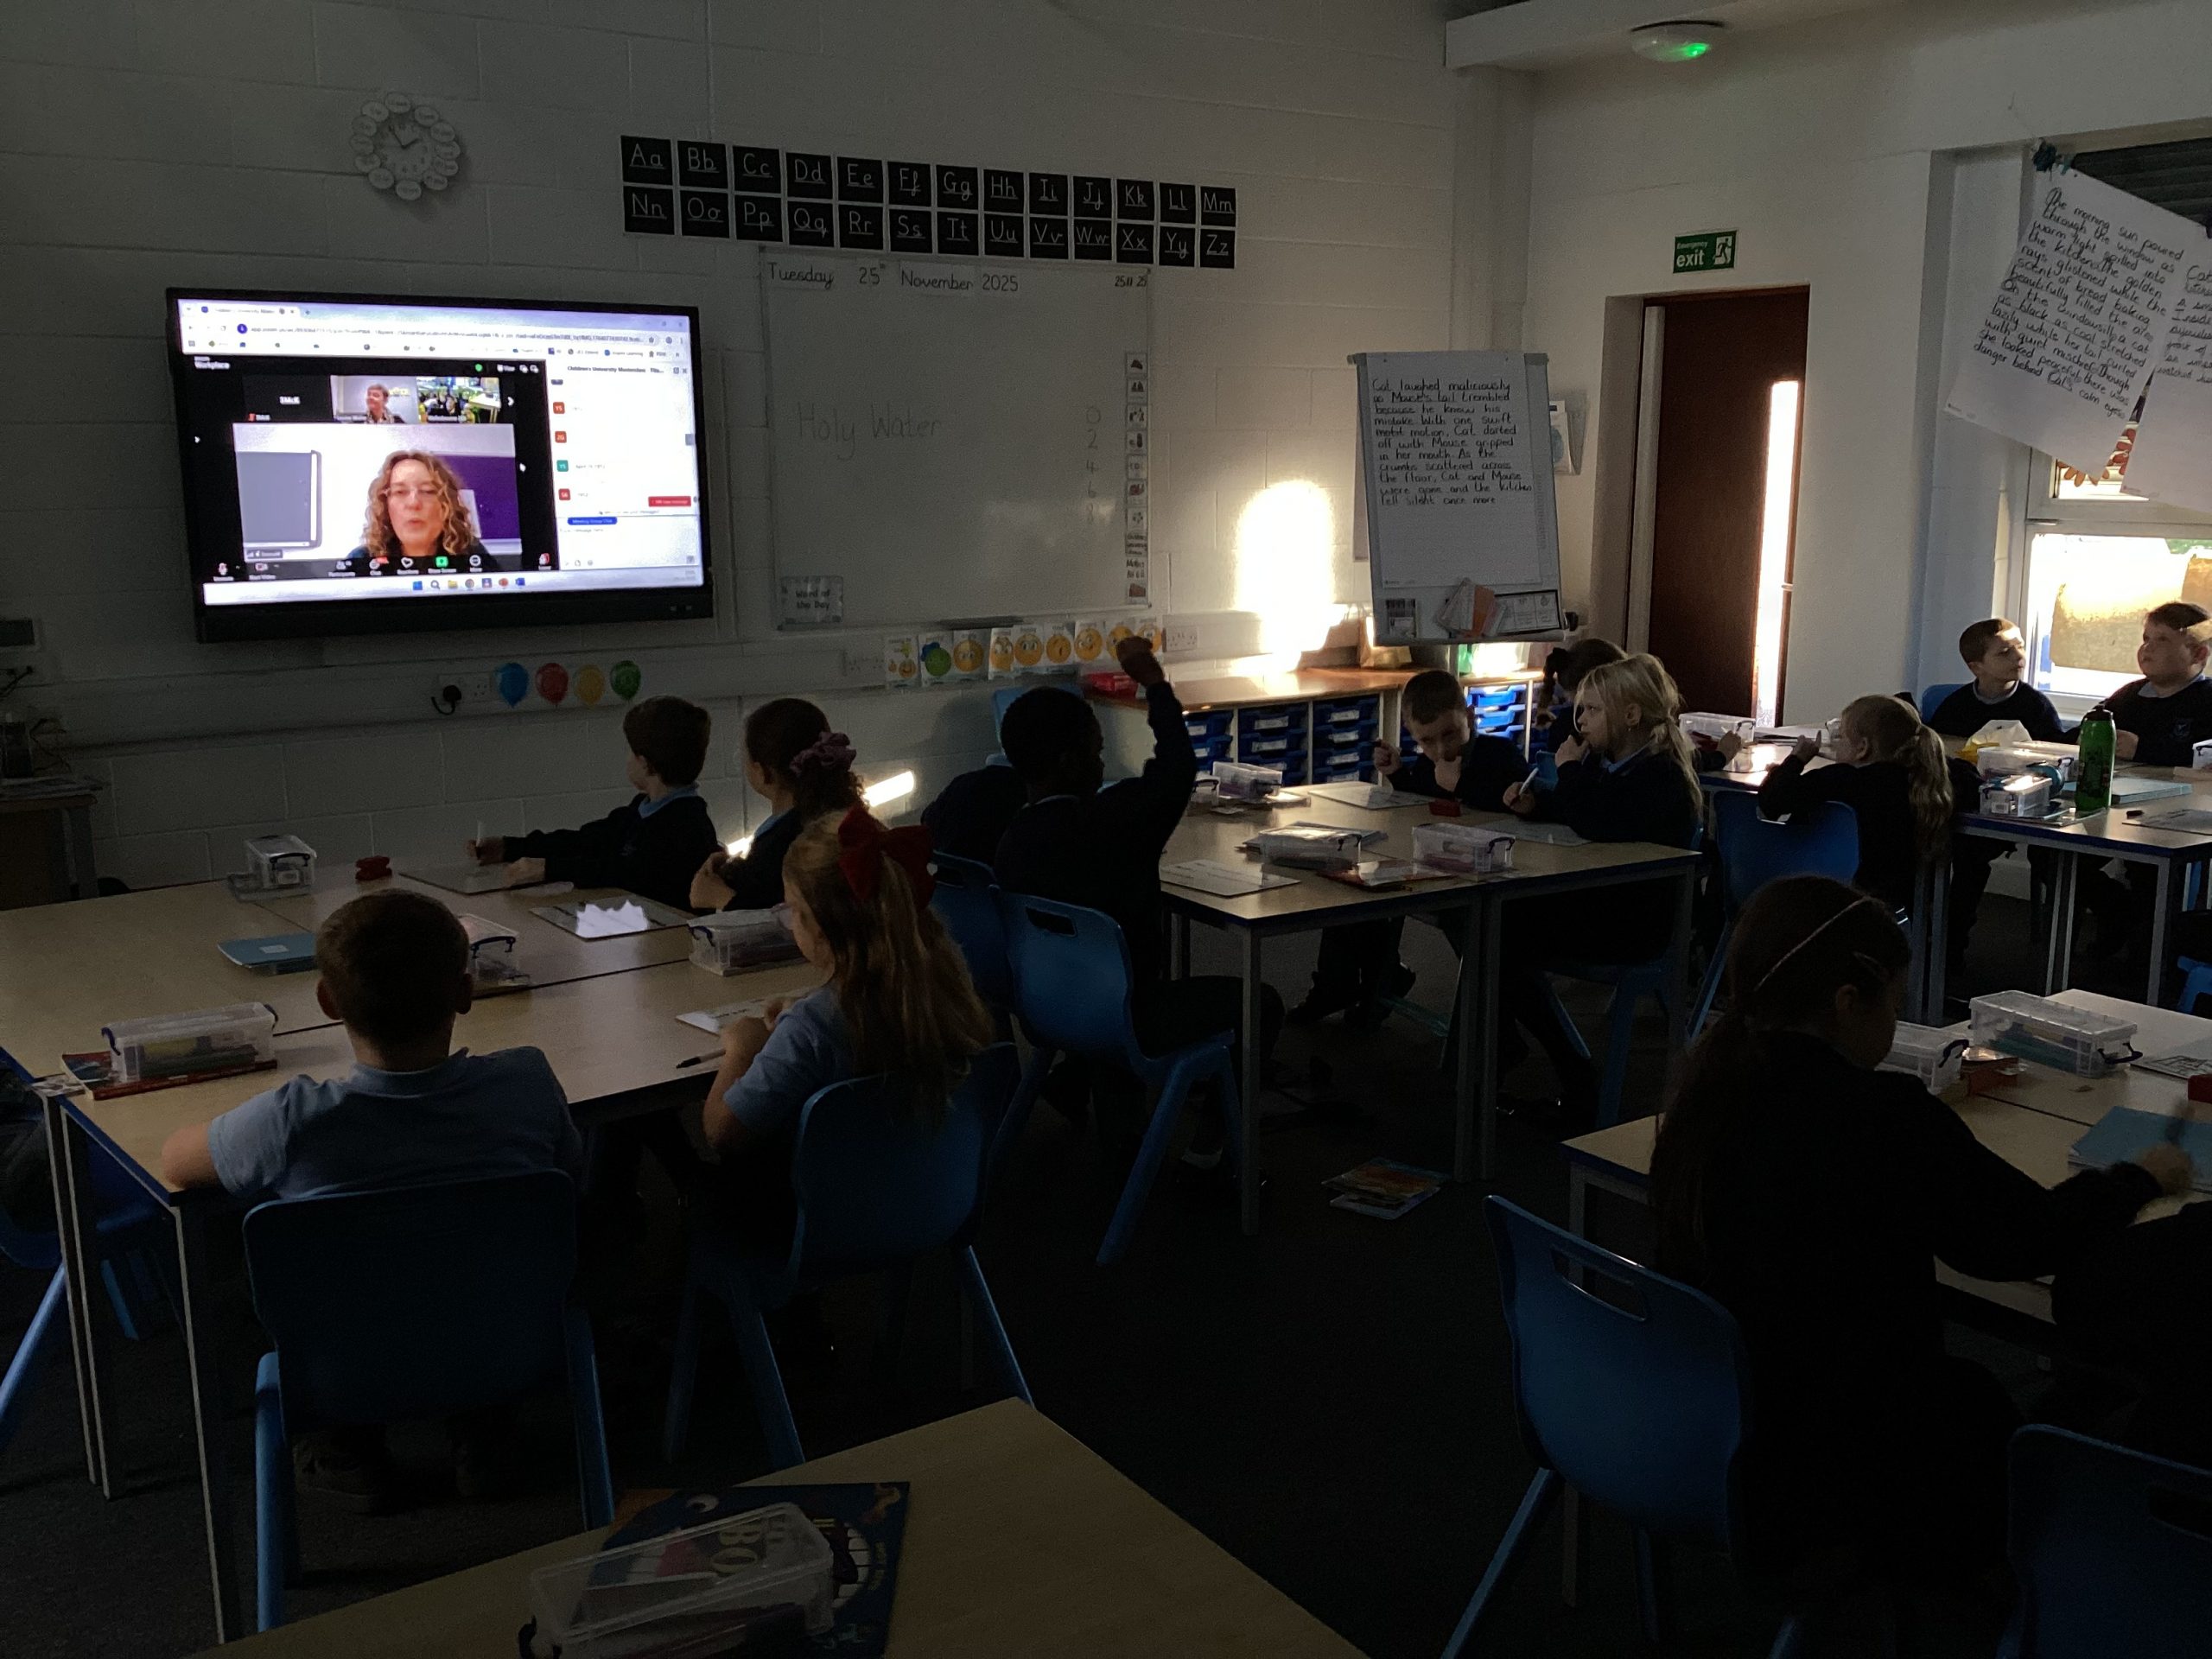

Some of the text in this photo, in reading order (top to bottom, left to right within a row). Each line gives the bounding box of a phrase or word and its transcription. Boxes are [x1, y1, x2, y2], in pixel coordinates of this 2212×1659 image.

[629, 142, 1232, 212] Aa Bb Cc Dd Ee Ff Gg Hh Ii Jj Kk Ll Mm
[2042, 186, 2067, 218] The
[631, 193, 1229, 259] Nn Oo Pp Qq Rr Ss Tt Uu Vv Ww Xx Yy Zz
[1675, 249, 1706, 267] exit
[767, 262, 835, 290] Tuesday
[900, 270, 973, 290] November
[982, 274, 1019, 292] 2025
[1372, 378, 1510, 395] Cat laughed maliciously
[1391, 391, 1433, 403] Mouse's
[1437, 391, 1455, 403] tail
[1461, 391, 1510, 402] trembled
[1375, 402, 1502, 415] because he knew his
[1481, 412, 1512, 425] swift
[797, 401, 943, 461] Holy Water
[1453, 423, 1476, 436] Cat
[1483, 423, 1517, 435] darted
[1087, 429, 1099, 450] 2
[1377, 436, 1514, 452] off with Mouse gripped
[1395, 448, 1410, 460] her
[1458, 449, 1471, 460] As
[1478, 448, 1497, 459] the
[1379, 460, 1512, 472] crumbs scattered across
[1379, 470, 1522, 484] the floor, Cat and Mouse
[1379, 480, 1532, 496] were gone and the kitchen
[1381, 495, 1398, 506] fell
[1443, 496, 1466, 505] once
[795, 588, 830, 598] Word of
[797, 601, 830, 612] the Day
